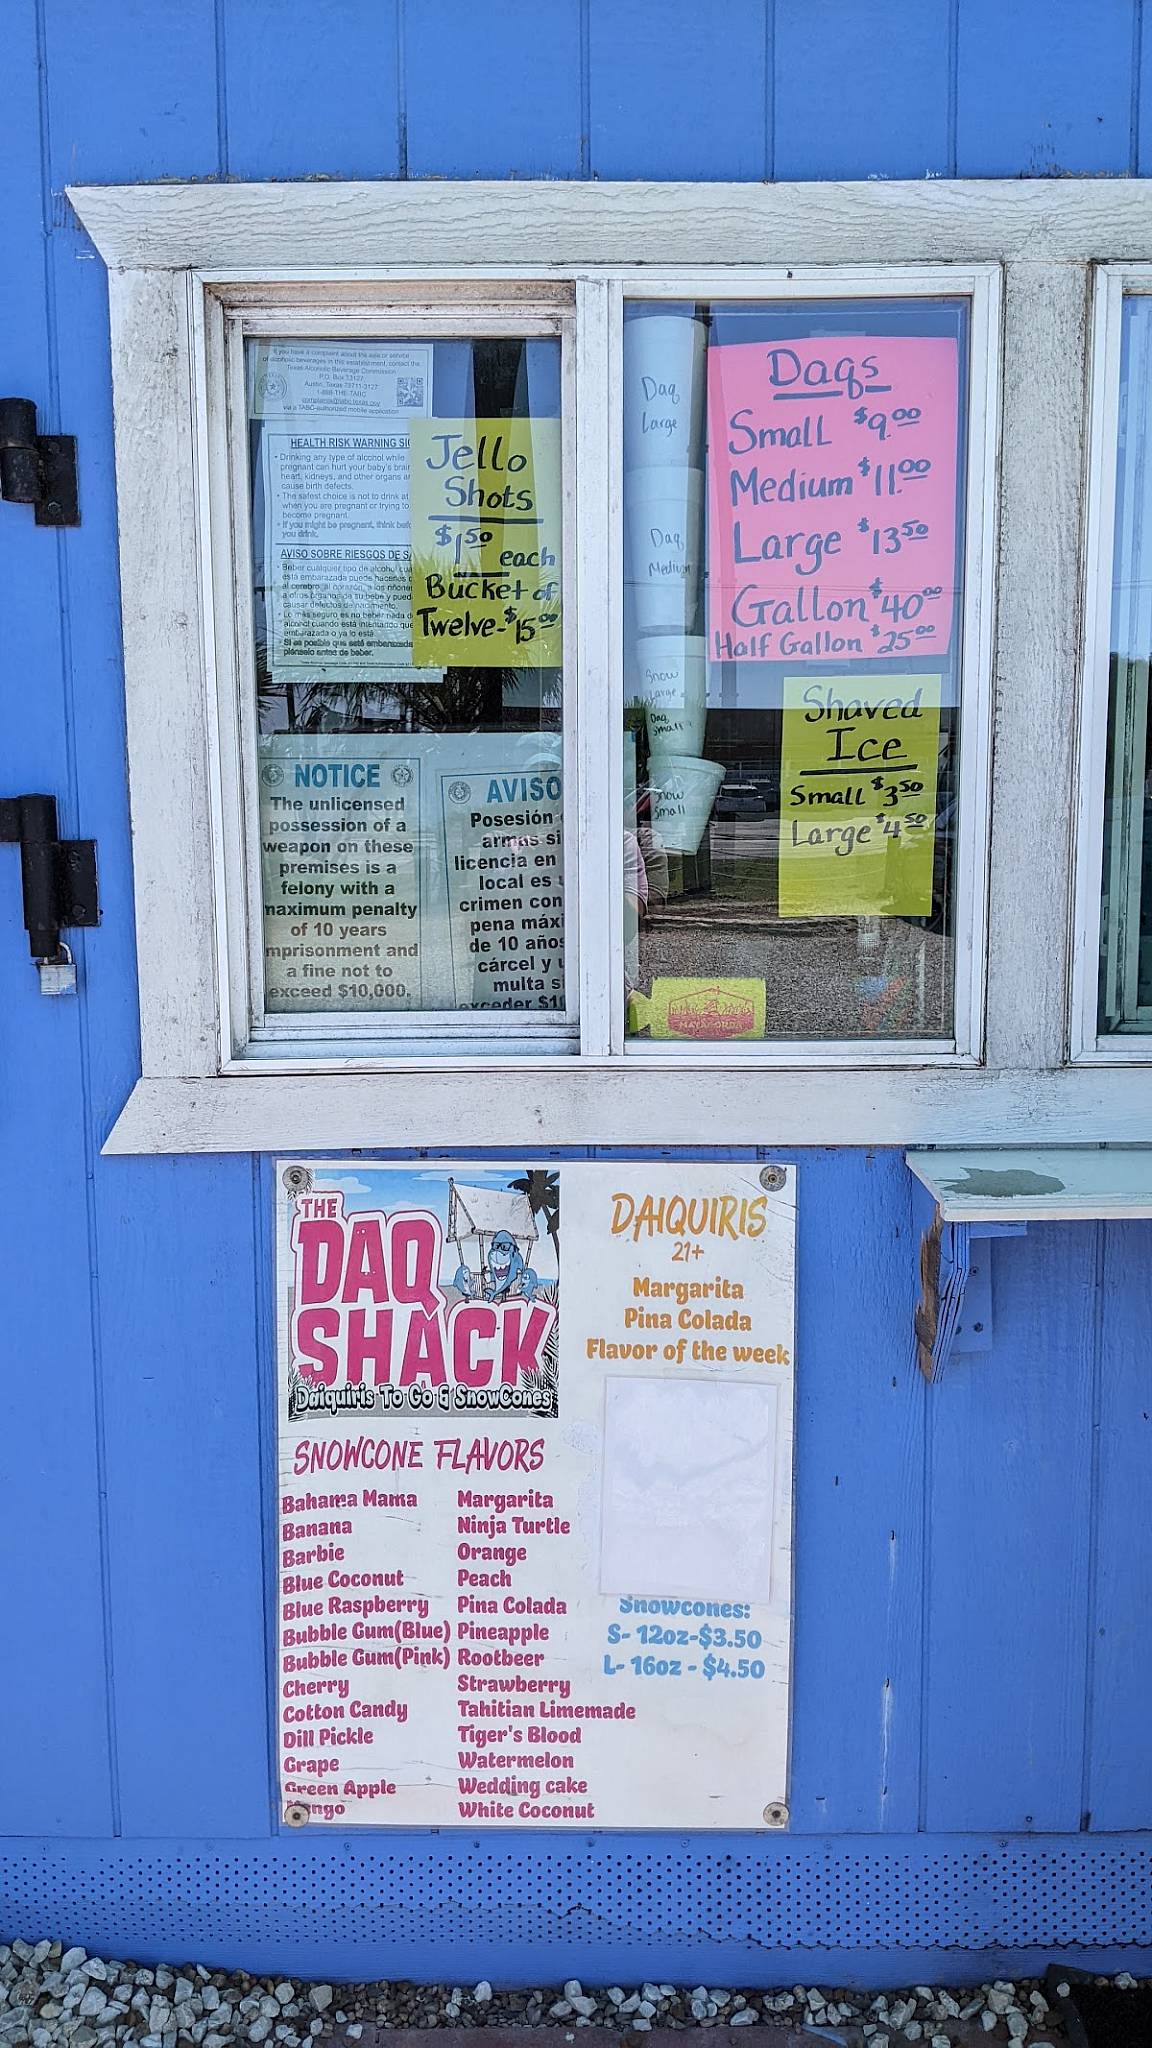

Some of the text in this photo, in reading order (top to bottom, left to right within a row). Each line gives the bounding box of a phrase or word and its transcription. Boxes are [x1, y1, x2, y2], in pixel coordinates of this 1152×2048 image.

[767, 349, 879, 399] Daqs
[291, 438, 326, 448] HEALTH
[329, 438, 350, 448] RISK
[353, 438, 396, 448] WARNING
[728, 409, 832, 455] Small
[280, 454, 310, 462] Drinking
[314, 454, 326, 462] any
[329, 454, 345, 462] type
[426, 434, 527, 472] Jello
[445, 476, 534, 510] Shots
[730, 466, 852, 506] Medium
[281, 549, 308, 559] AVISO
[311, 549, 342, 559] SOBRE
[345, 550, 385, 559] RIESGOS
[388, 550, 400, 559] DE
[500, 547, 555, 566] each
[734, 521, 842, 576] Large
[425, 573, 558, 600] Bucket of
[732, 584, 869, 630] Gallon
[715, 632, 773, 659] Half
[779, 631, 863, 655] Gallon
[803, 684, 922, 723] Shaved
[827, 726, 908, 762] Ice
[295, 764, 380, 788] NOTICE
[271, 796, 405, 811] The unlicensed
[790, 785, 865, 807] Small
[269, 818, 407, 834] possession of a
[471, 810, 553, 828] Posesión
[263, 840, 413, 856] weapon on these
[482, 834, 539, 847] armas
[792, 819, 872, 857] Large
[279, 861, 397, 877] premises is a
[455, 854, 556, 871] licencia en
[281, 881, 395, 897] felony with a
[480, 875, 551, 890] local es
[352, 902, 417, 919] penalty
[459, 895, 562, 912] crimen con
[290, 922, 387, 940] of 10 years
[470, 920, 514, 936] pena
[266, 944, 418, 961] mprisonment and
[469, 938, 490, 952] de
[498, 936, 518, 951] 10
[287, 964, 392, 977] a fine not to
[478, 955, 551, 974] cárcel y
[270, 983, 411, 1000] exceed $10,000.
[493, 976, 544, 992] multa
[301, 1199, 338, 1219] THE
[610, 1192, 769, 1242] DAIQUIRIS
[672, 1241, 704, 1262] 21+
[298, 1219, 441, 1314] DAQ
[633, 1276, 744, 1304] Margarita
[624, 1307, 752, 1331] Pina Colada
[297, 1308, 550, 1388] SHACK
[587, 1338, 790, 1365] Flavor of the week
[296, 1384, 553, 1414] Daiquiris To Go & SnowCones
[294, 1436, 545, 1475] SNOWCONE FLAVORS
[282, 1489, 417, 1514] Bahama Mama
[458, 1489, 554, 1513] Margarita
[282, 1521, 352, 1541] Banana
[458, 1515, 570, 1539] Ninja Turtle
[283, 1542, 345, 1568] Barbie
[458, 1543, 527, 1566] Orange
[283, 1570, 404, 1595] Blue Coconut
[458, 1569, 512, 1586] Peach
[283, 1595, 429, 1621] Blue Raspberry
[458, 1595, 567, 1614] Pina Colada
[619, 1597, 750, 1619] Snowcones:
[283, 1620, 451, 1647] Bubble Gum(Blue)
[457, 1621, 549, 1646] Pineapple
[607, 1623, 762, 1650] S- 12oz-$3.50
[283, 1647, 450, 1673] Bubble Gum(Pink)
[458, 1648, 545, 1666] Rootbeer
[604, 1654, 624, 1675] L-
[630, 1655, 682, 1676] 16oz
[703, 1653, 766, 1680] $4.50
[283, 1679, 349, 1698] Cherry
[458, 1674, 571, 1698] Strawberry
[283, 1700, 408, 1723] Cotton Candy
[458, 1700, 636, 1719] Tahitian Limemade
[284, 1727, 374, 1748] Dill Pickle
[458, 1724, 582, 1748] Tiger's Blood
[284, 1757, 339, 1777] Grape
[458, 1751, 574, 1769] Watermelon
[285, 1780, 396, 1798] Green Apple
[458, 1775, 588, 1798] Wedding cake
[286, 1800, 345, 1820] ngo
[458, 1801, 595, 1818] White Coconut
